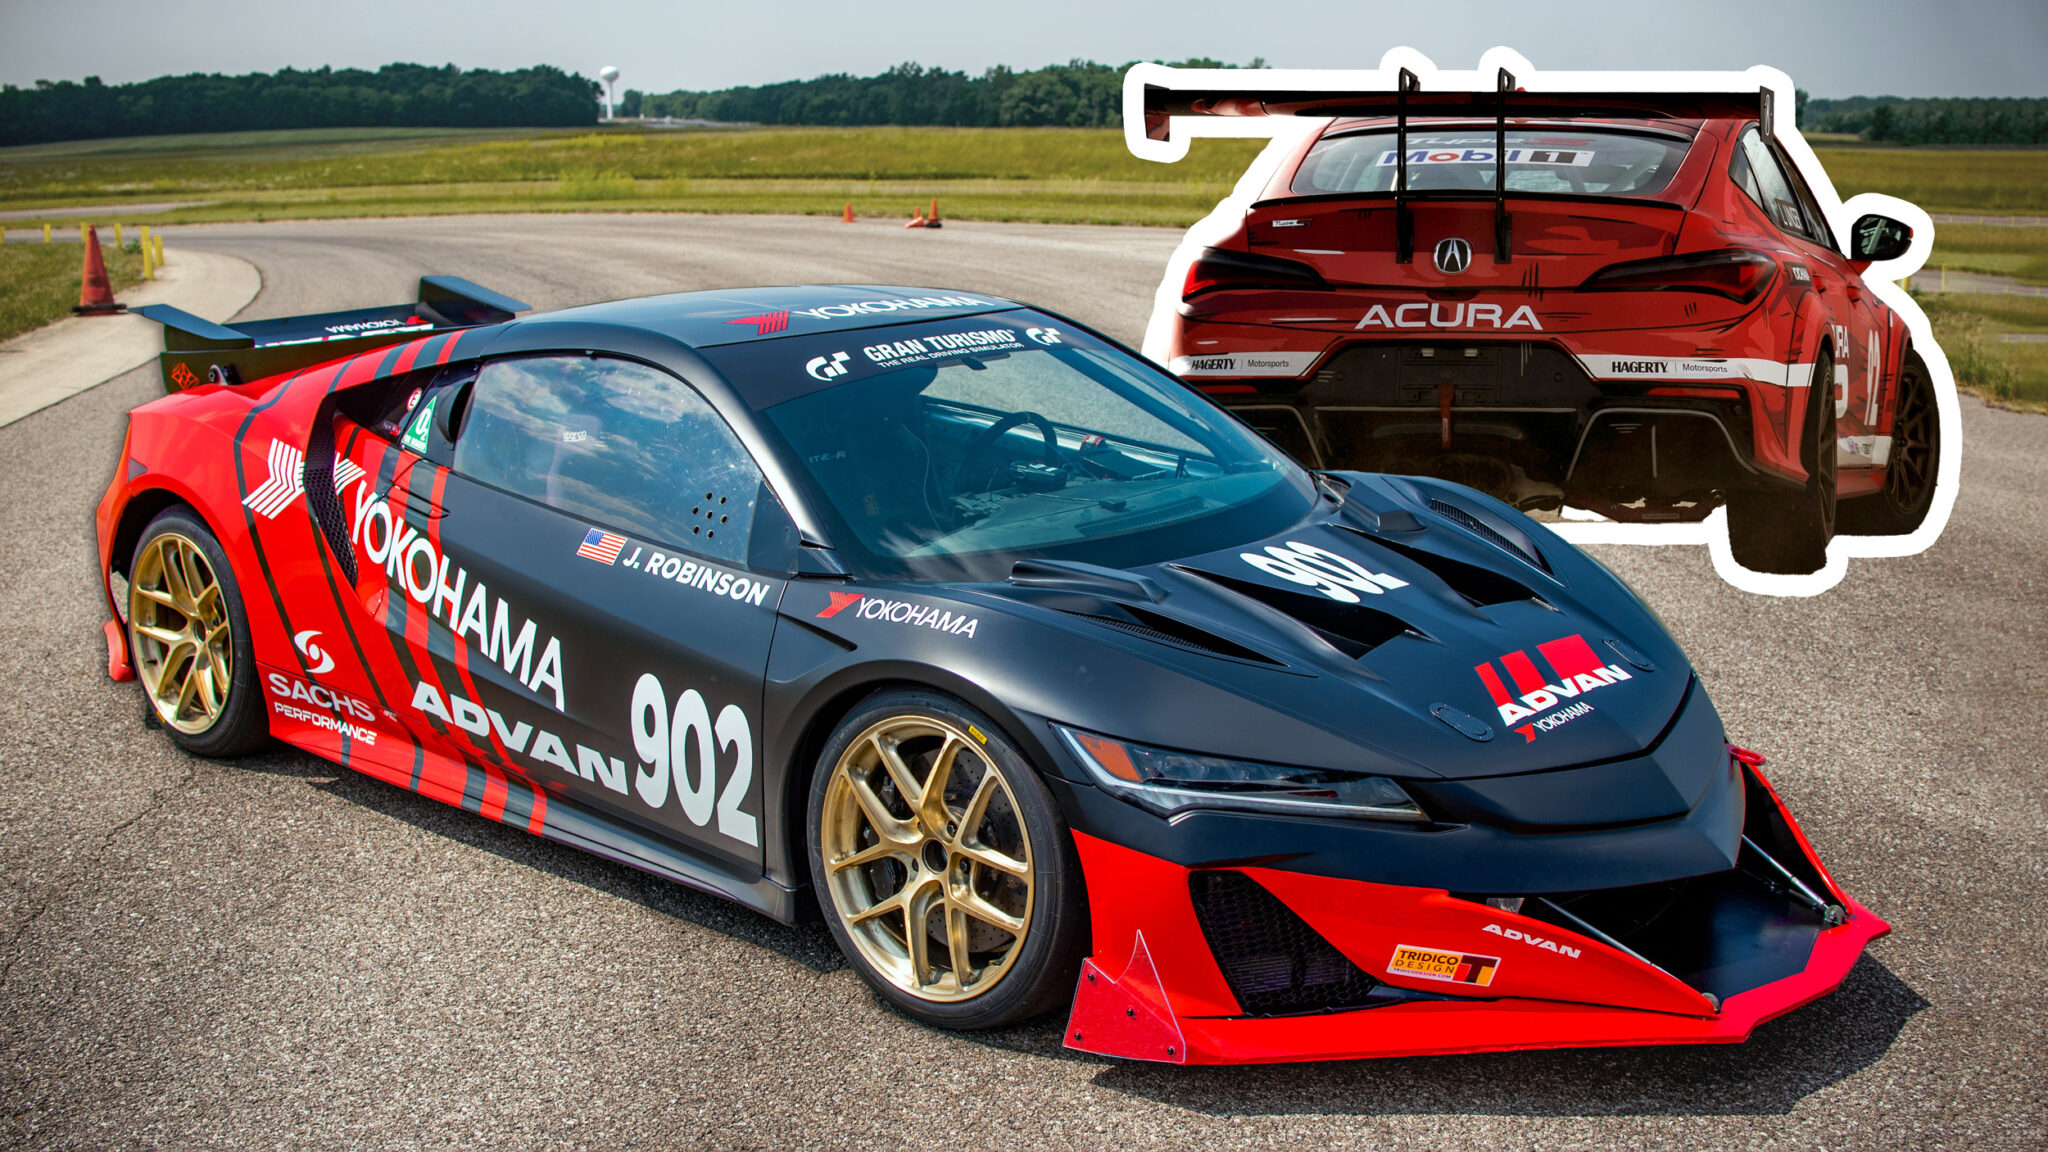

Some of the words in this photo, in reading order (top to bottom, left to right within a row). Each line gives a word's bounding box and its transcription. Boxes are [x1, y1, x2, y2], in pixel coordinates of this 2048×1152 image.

[1383, 150, 1521, 164] Mobl
[793, 295, 995, 320] YOKOHAMA
[1355, 302, 1543, 331] ACURA
[324, 318, 405, 334] YOKOHAMA
[863, 338, 929, 362] GRAN
[877, 359, 902, 369] THE
[901, 353, 930, 364] REAL
[930, 347, 970, 359] DRIVING
[966, 341, 1025, 354] SIMULATOR
[1191, 358, 1235, 370] HAGERTY
[1247, 359, 1290, 368] Motorsports
[1611, 361, 1668, 374] HAGERTY
[1682, 363, 1728, 373] Motorsports
[622, 547, 641, 570] J.
[644, 551, 770, 606] ROBINSON
[1240, 540, 1410, 603] 902
[352, 480, 565, 713] YOKOHAMA
[854, 597, 980, 639] YOKOHAMA
[268, 672, 376, 722] SACHS
[1497, 664, 1633, 727] ADVAN
[274, 701, 378, 746] PERFORMANCE
[1532, 701, 1595, 732] YOKOHAMA
[411, 680, 629, 796] ADVAN
[630, 672, 759, 848] 902
[1481, 923, 1582, 959] ADVAN
[1395, 959, 1455, 974] DESIGN
[1400, 950, 1459, 966] TRIDICO
